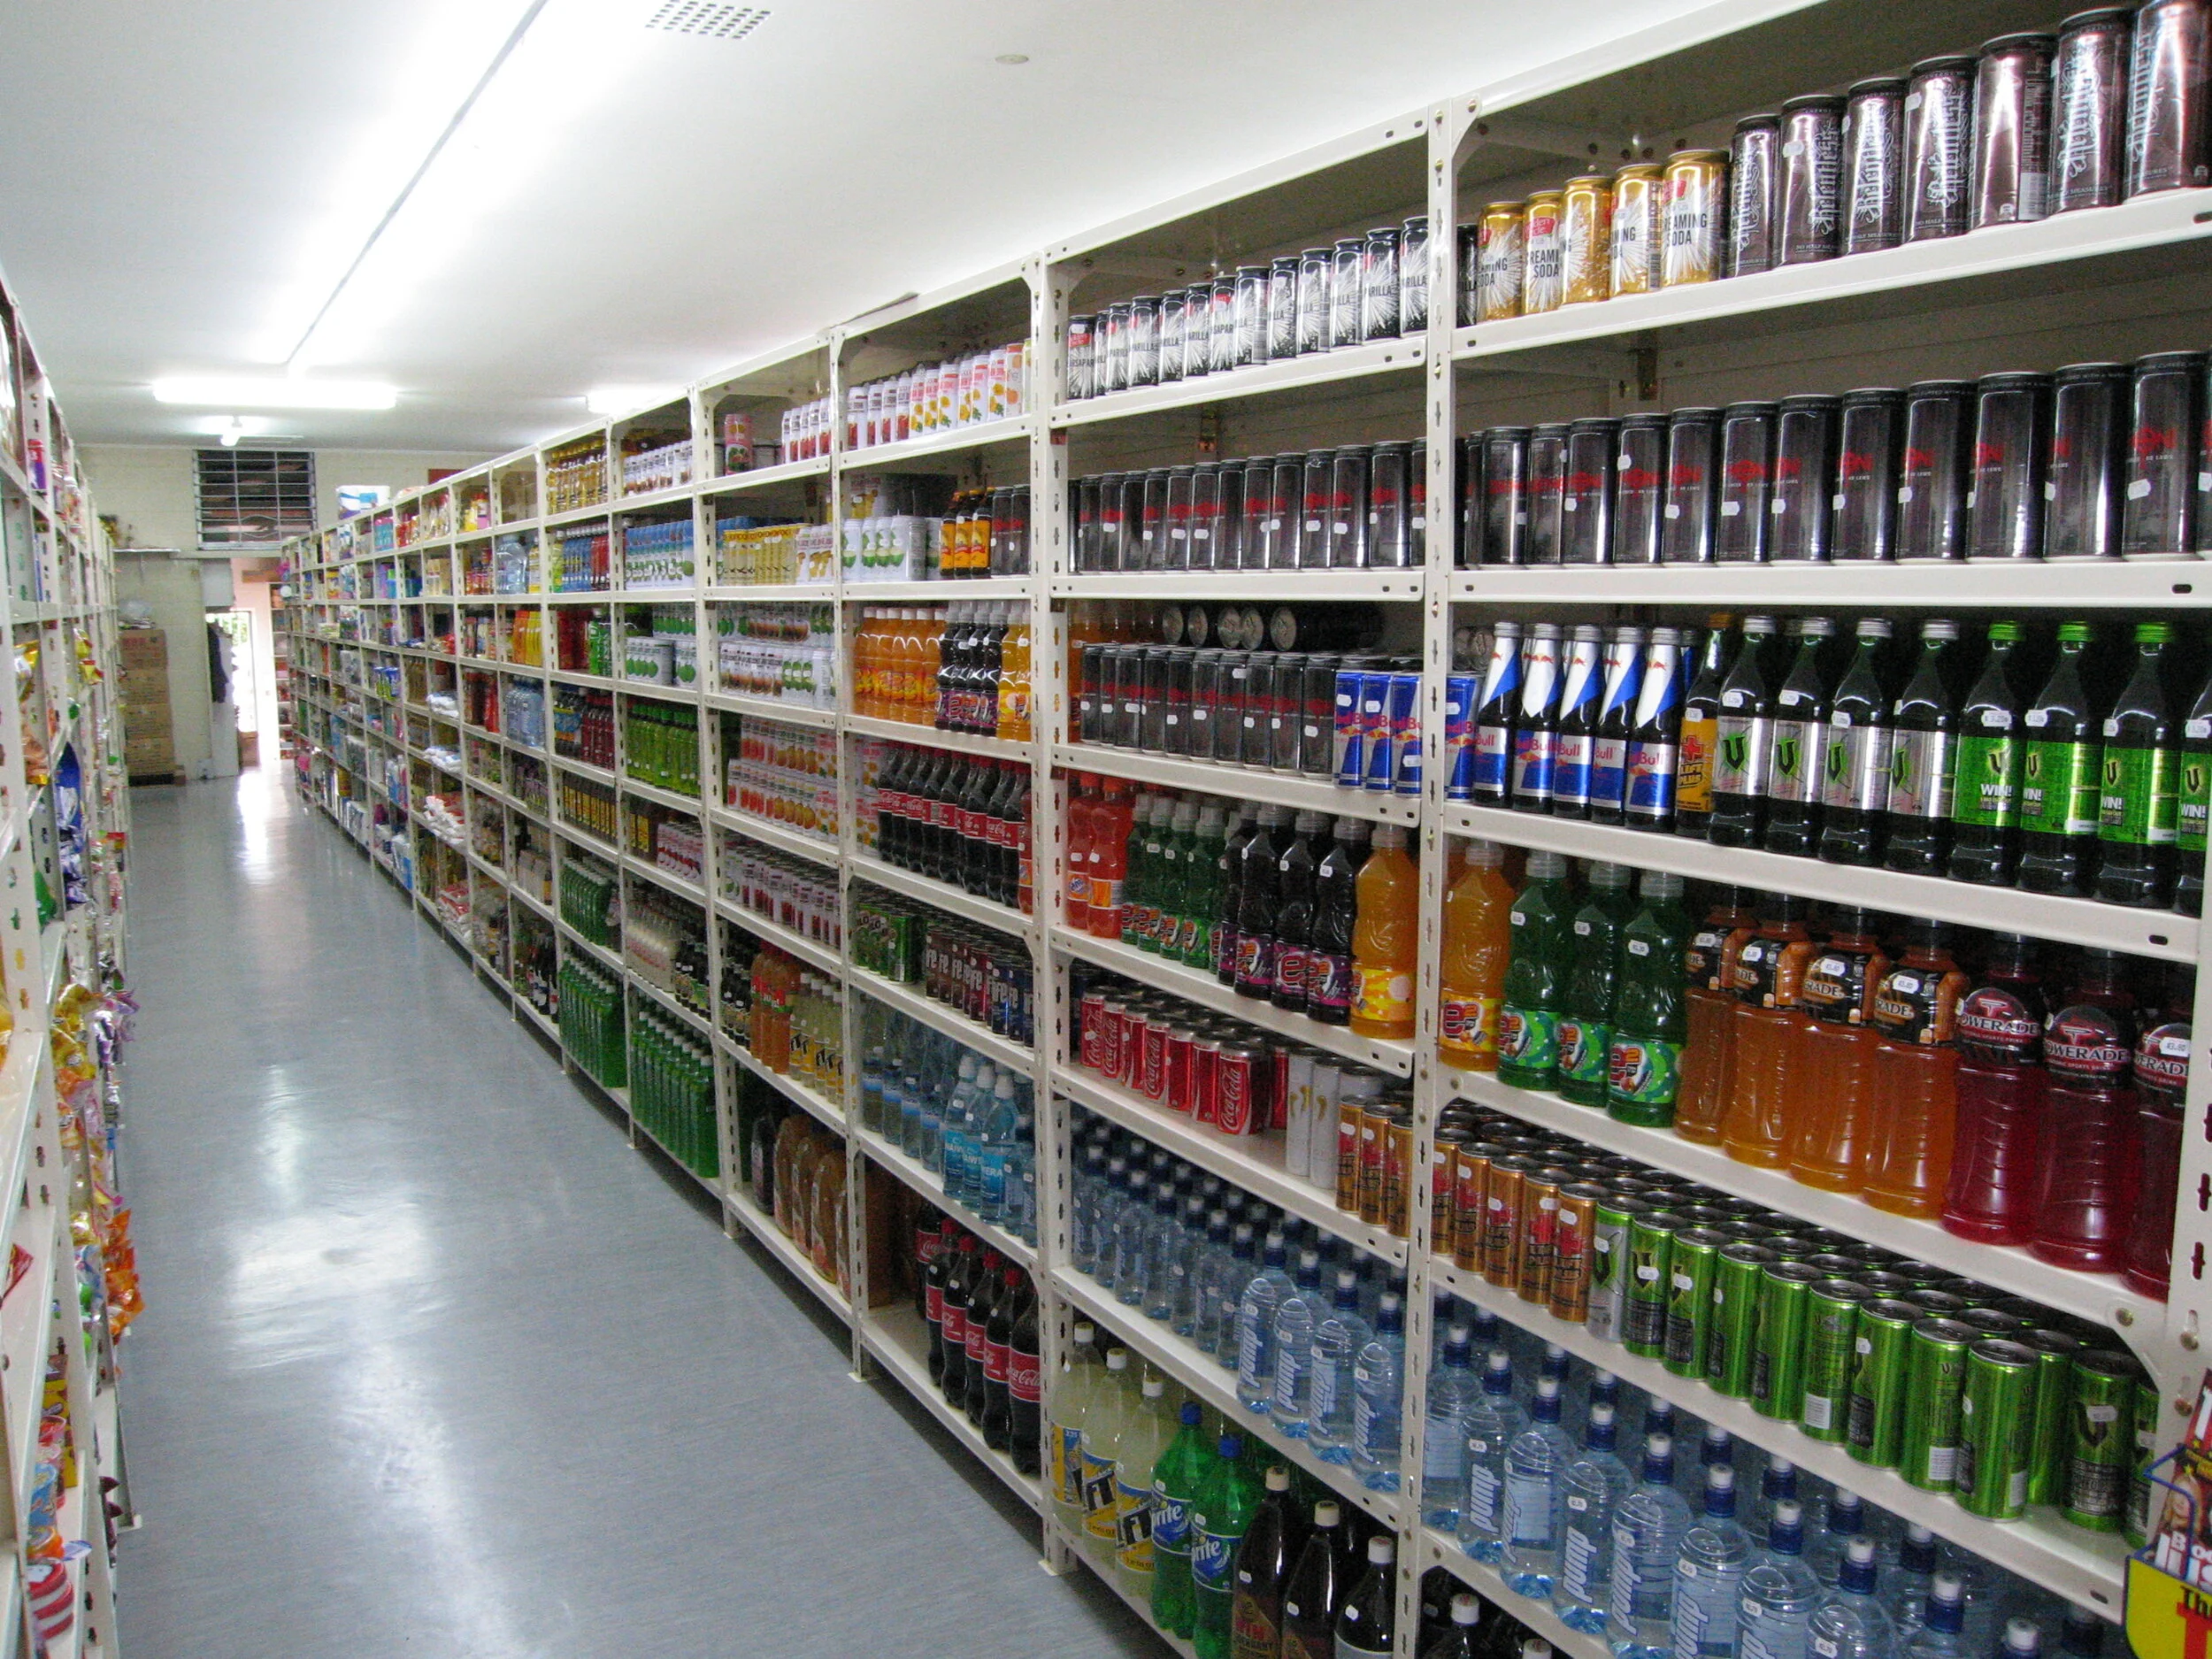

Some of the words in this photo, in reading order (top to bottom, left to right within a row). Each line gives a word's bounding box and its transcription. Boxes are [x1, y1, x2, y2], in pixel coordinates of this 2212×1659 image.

[1667, 231, 1692, 247] SODA
[1528, 249, 1559, 263] REAMI
[1533, 264, 1559, 279] SODA
[1407, 717, 1423, 729] Bu
[1560, 743, 1580, 757] Bull
[1980, 782, 2012, 797] WIN!
[1875, 999, 1913, 1018] RADE
[1958, 1012, 2039, 1035] OWERADE
[1277, 1348, 1302, 1413] pump
[1354, 1395, 1377, 1463] pump
[1470, 1463, 1502, 1535] pump
[1152, 1504, 1184, 1526] rite
[1192, 1540, 1222, 1562] rite
[1562, 1525, 1598, 1604] pump
[1612, 1547, 1642, 1636] pump
[2180, 1584, 2212, 1621] Th
[1676, 1588, 1709, 1659] ump
